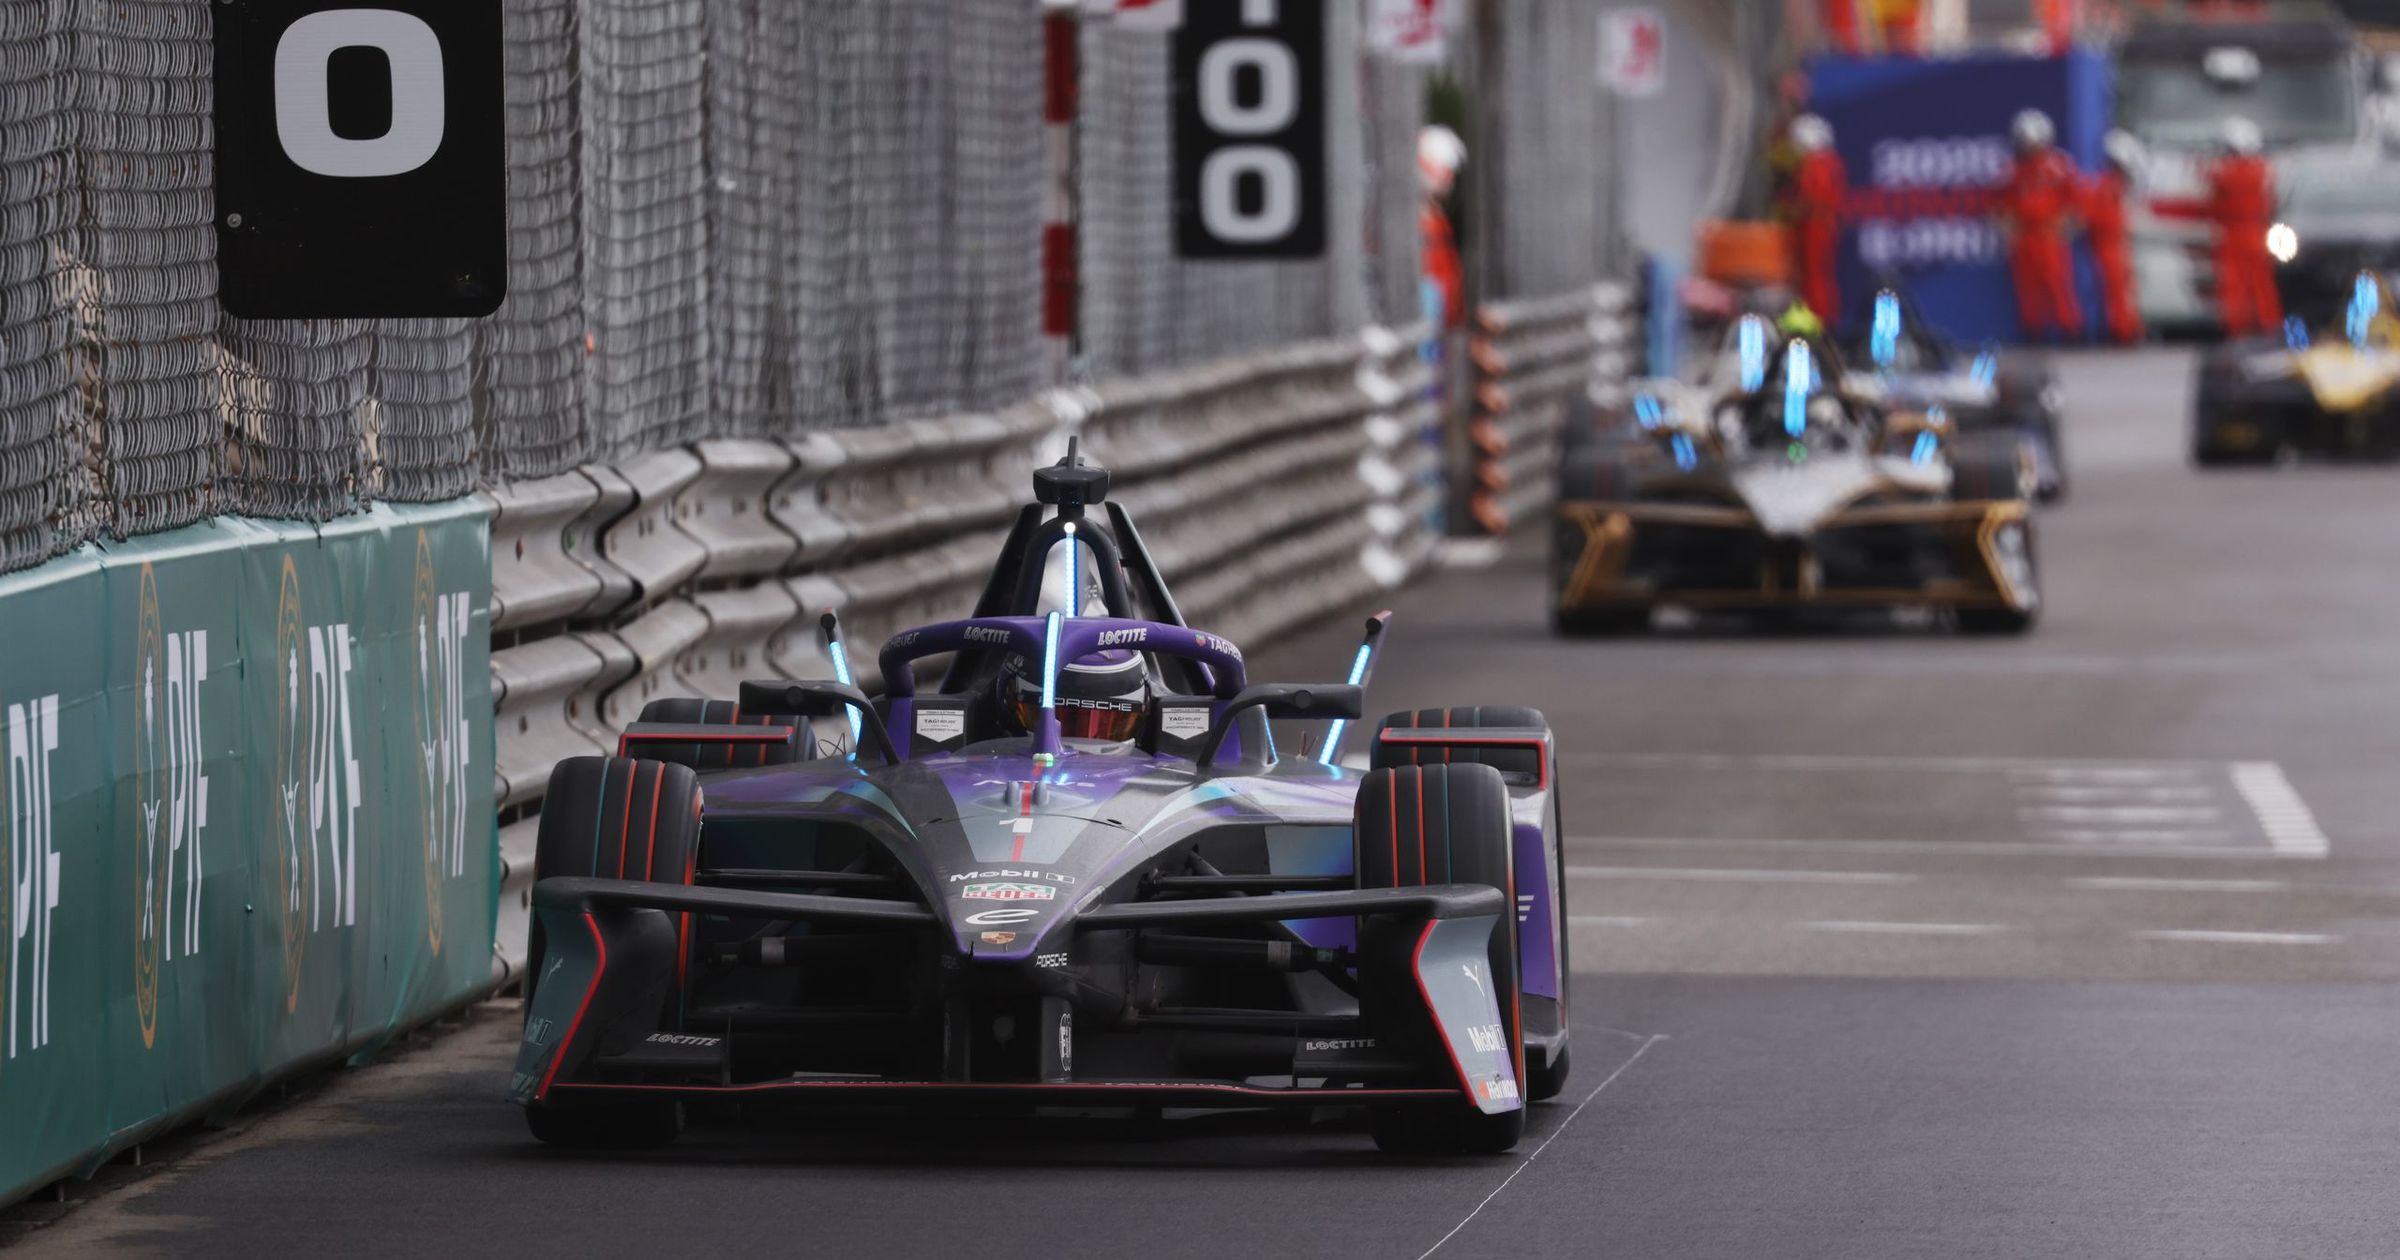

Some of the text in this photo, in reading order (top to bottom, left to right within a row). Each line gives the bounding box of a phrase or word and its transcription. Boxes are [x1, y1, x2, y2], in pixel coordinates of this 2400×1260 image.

[274, 8, 445, 177] 0
[964, 626, 1010, 643] LOCTITE
[1098, 628, 1147, 645] LOCTITE
[1039, 697, 1132, 712] ORSCHE
[437, 592, 470, 878] PIF
[166, 630, 208, 961] PIF
[9, 693, 60, 1059] PIF
[950, 870, 1039, 882] Mobil
[1036, 953, 1067, 968] PORSCHE
[645, 1033, 721, 1046] LOCTITE
[1306, 1039, 1376, 1051] LOCTITE
